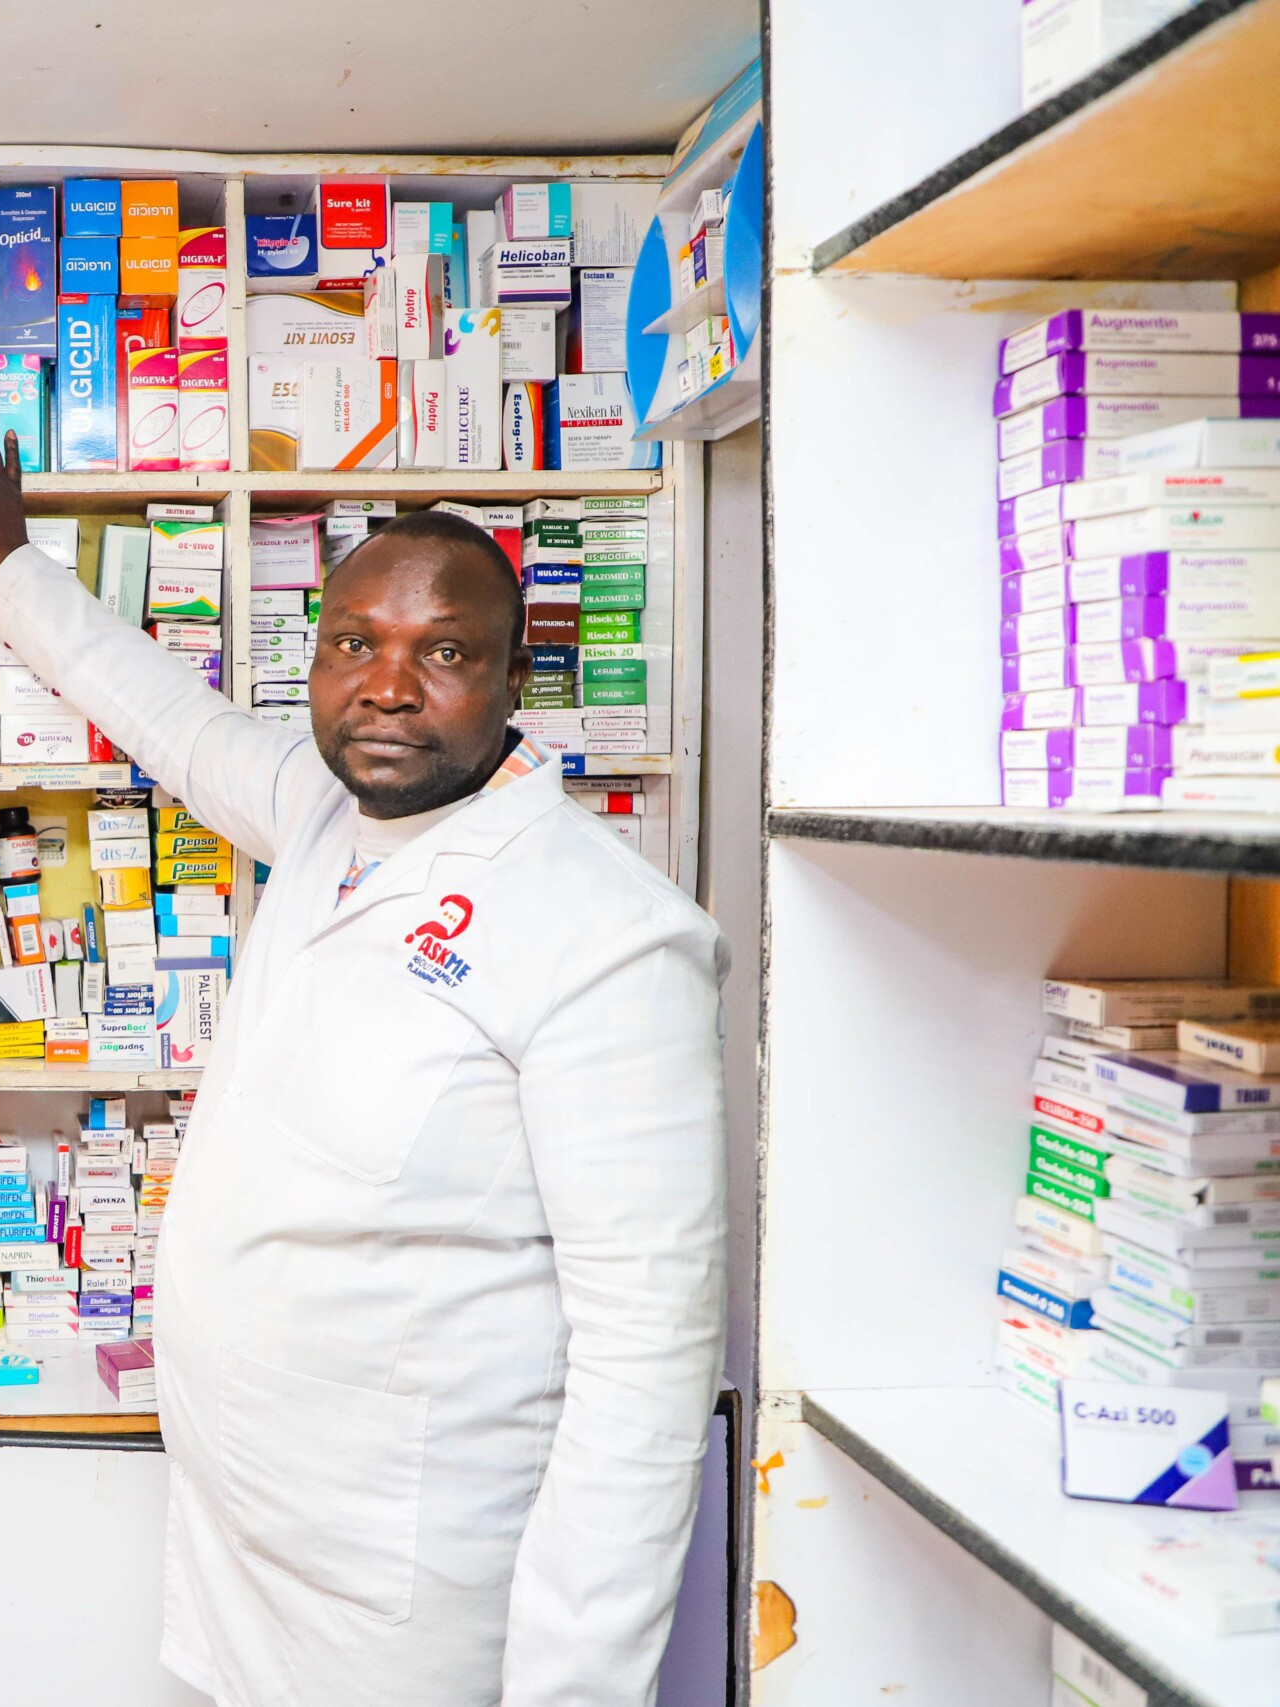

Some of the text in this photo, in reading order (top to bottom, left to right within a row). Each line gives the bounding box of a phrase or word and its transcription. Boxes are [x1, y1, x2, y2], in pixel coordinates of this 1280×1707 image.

[71, 202, 116, 213] ULGICID
[327, 198, 370, 208] Sure kit
[0, 228, 41, 246] Opticid
[500, 249, 566, 262] Helicoban
[66, 262, 111, 272] ULGICID
[405, 288, 417, 328] Pylotrip
[310, 332, 354, 344] ESOVIT
[132, 374, 174, 385] DIGEVA-F
[567, 405, 622, 418] Nexiken Kit
[458, 387, 469, 464] HELICURE
[513, 394, 522, 460] Esofag-Kit
[585, 500, 643, 509] ROBIDOM-SR
[538, 569, 563, 577] NULOC
[158, 585, 194, 593] OMIS-20
[586, 615, 612, 624] Risek
[172, 836, 217, 851] Pepsol
[413, 954, 459, 988] ABOUT FAMILY
[199, 974, 211, 1041] PAL-DIGEST
[101, 1023, 146, 1032] SupraBact
[1, 1251, 32, 1260] NAPRIN
[87, 1278, 109, 1288] Ralef
